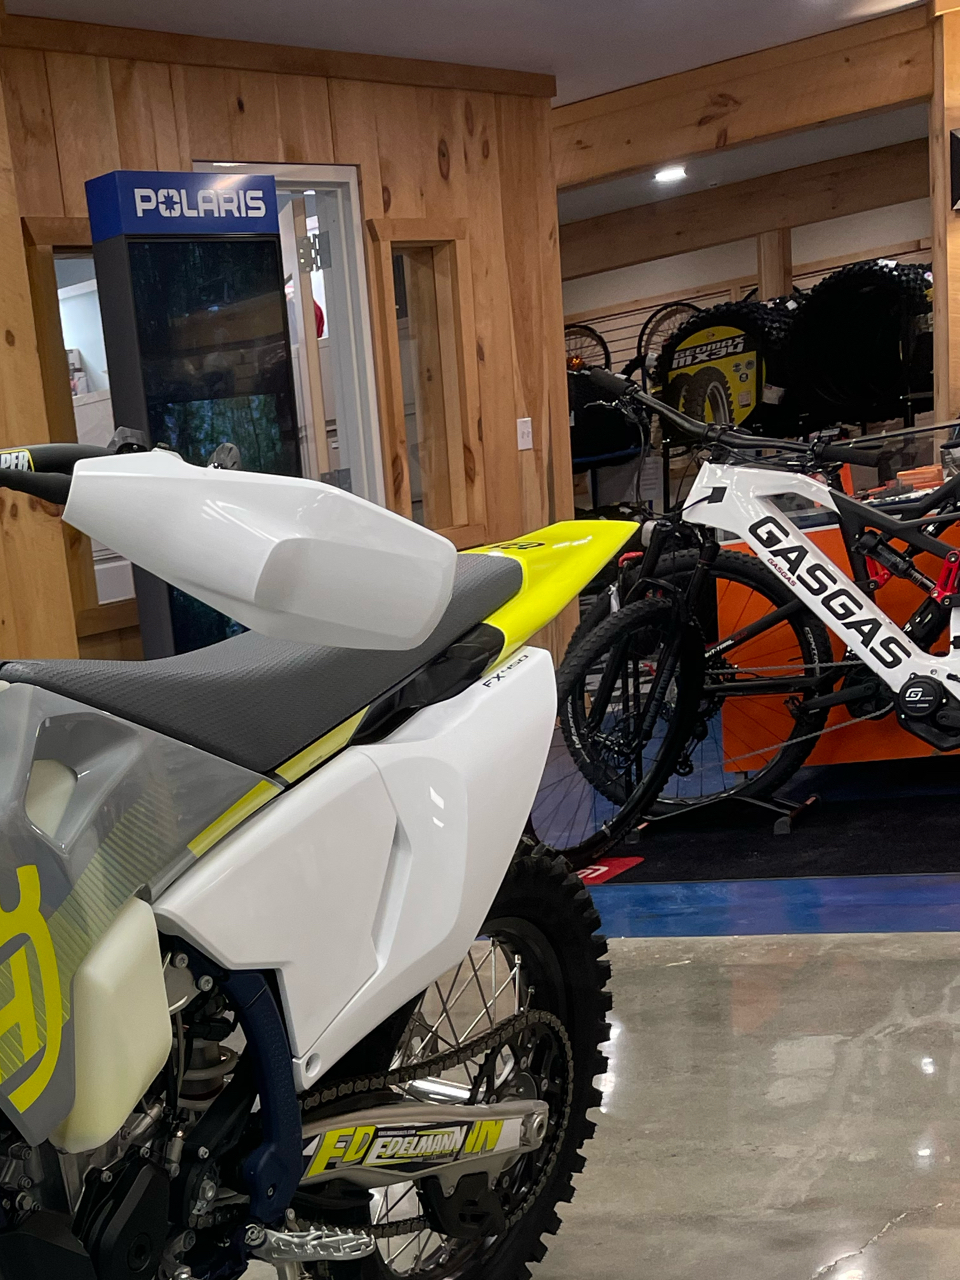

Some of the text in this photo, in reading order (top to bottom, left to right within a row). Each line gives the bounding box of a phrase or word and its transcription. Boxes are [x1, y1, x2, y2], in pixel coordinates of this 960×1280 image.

[134, 189, 266, 217] POLARIS
[673, 336, 746, 359] GEOMAX
[767, 557, 797, 587] GASGAS
[748, 515, 913, 670] GASGAS
[365, 1125, 469, 1164] EDELMANN
